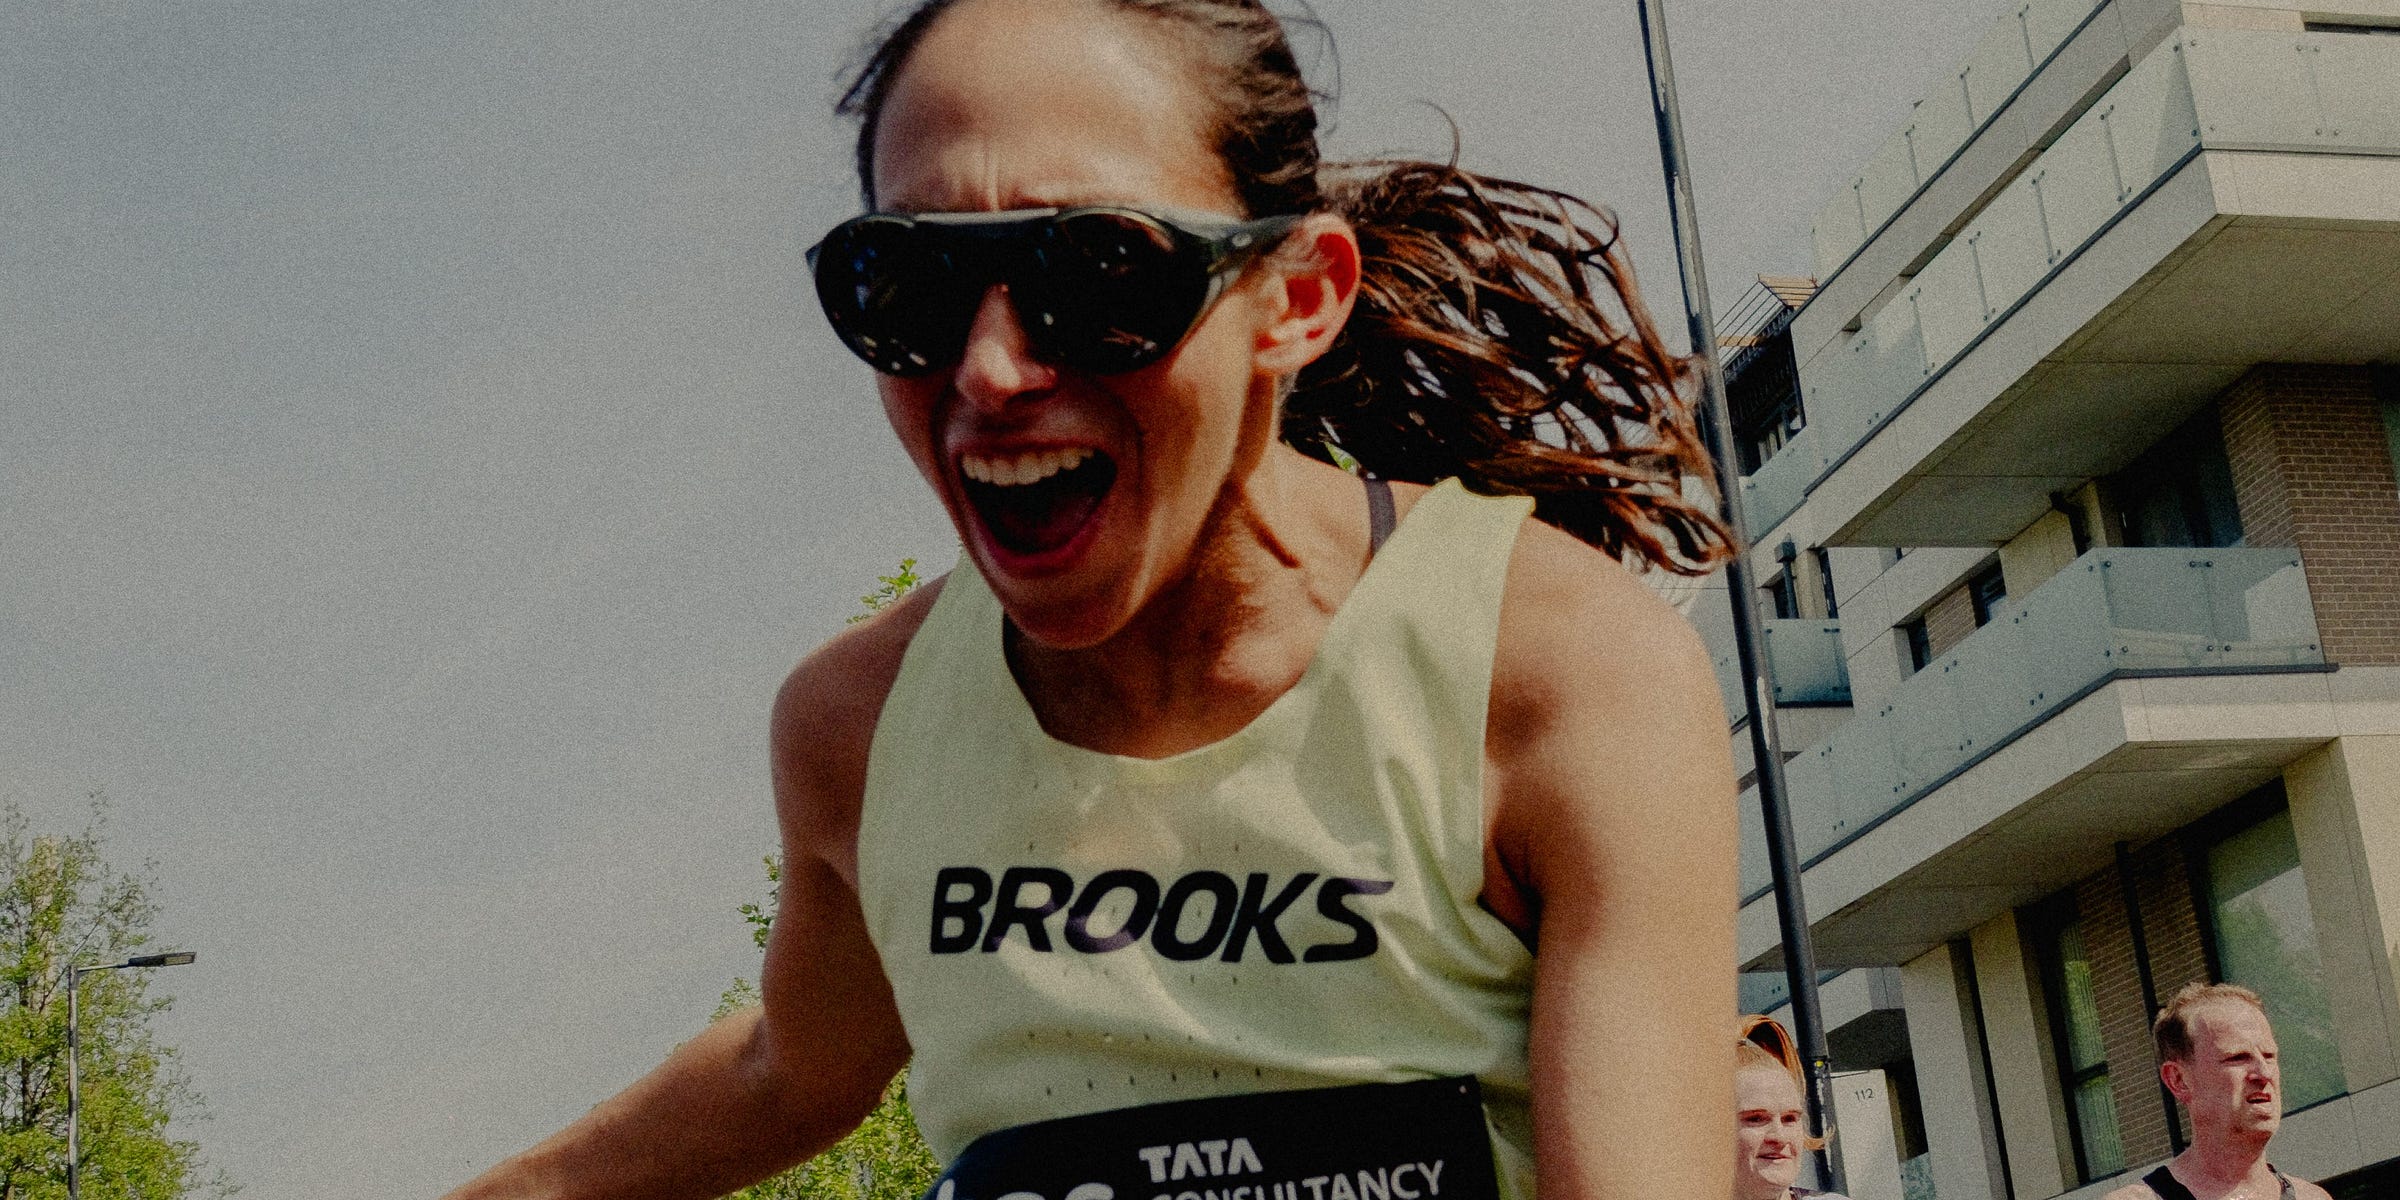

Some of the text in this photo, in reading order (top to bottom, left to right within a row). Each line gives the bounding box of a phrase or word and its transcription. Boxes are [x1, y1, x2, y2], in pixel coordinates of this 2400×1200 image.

[930, 866, 1395, 964] BROOKS
[1855, 1088, 1875, 1101] 112
[1139, 1137, 1264, 1183] TATA
[1149, 1159, 1445, 1200] LTANCY
